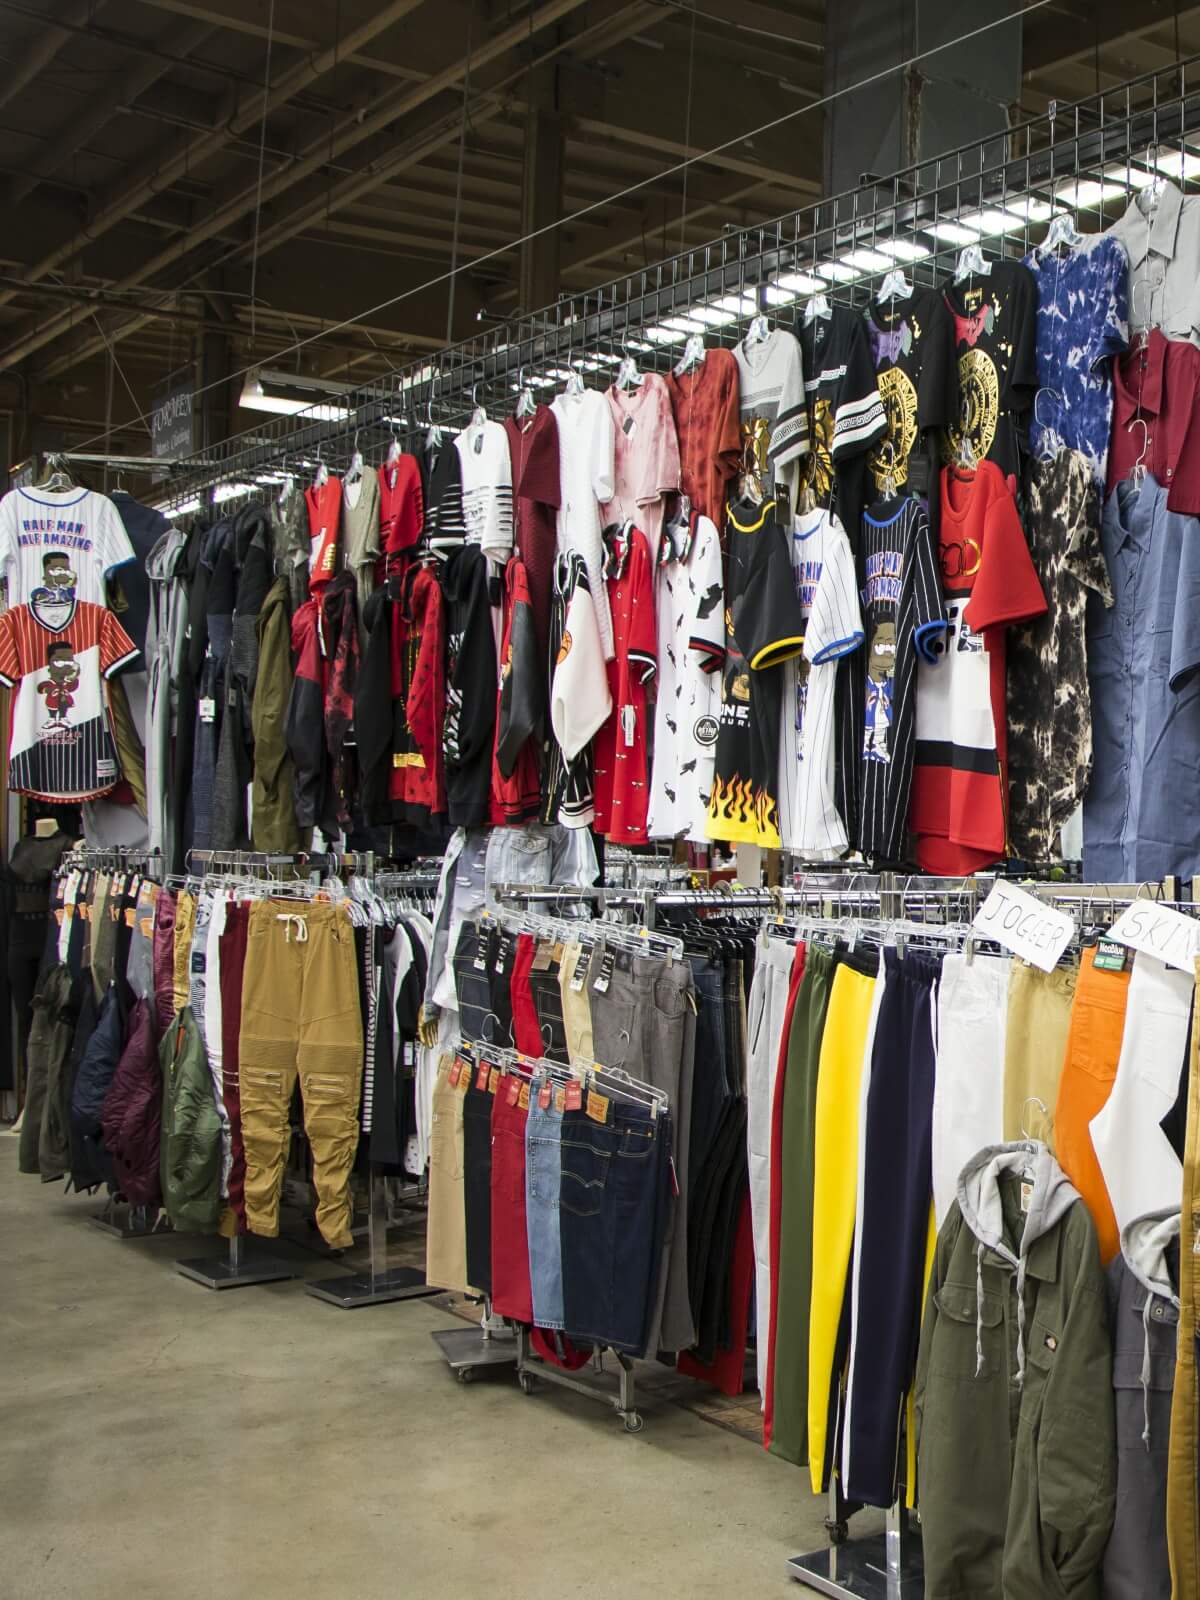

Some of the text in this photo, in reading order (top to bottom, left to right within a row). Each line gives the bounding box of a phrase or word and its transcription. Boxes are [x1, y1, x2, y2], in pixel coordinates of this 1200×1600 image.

[23, 519, 84, 535] HALF MAN
[43, 533, 93, 552] AMAZING
[720, 703, 750, 719] NE
[984, 893, 1065, 953] JOGGER
